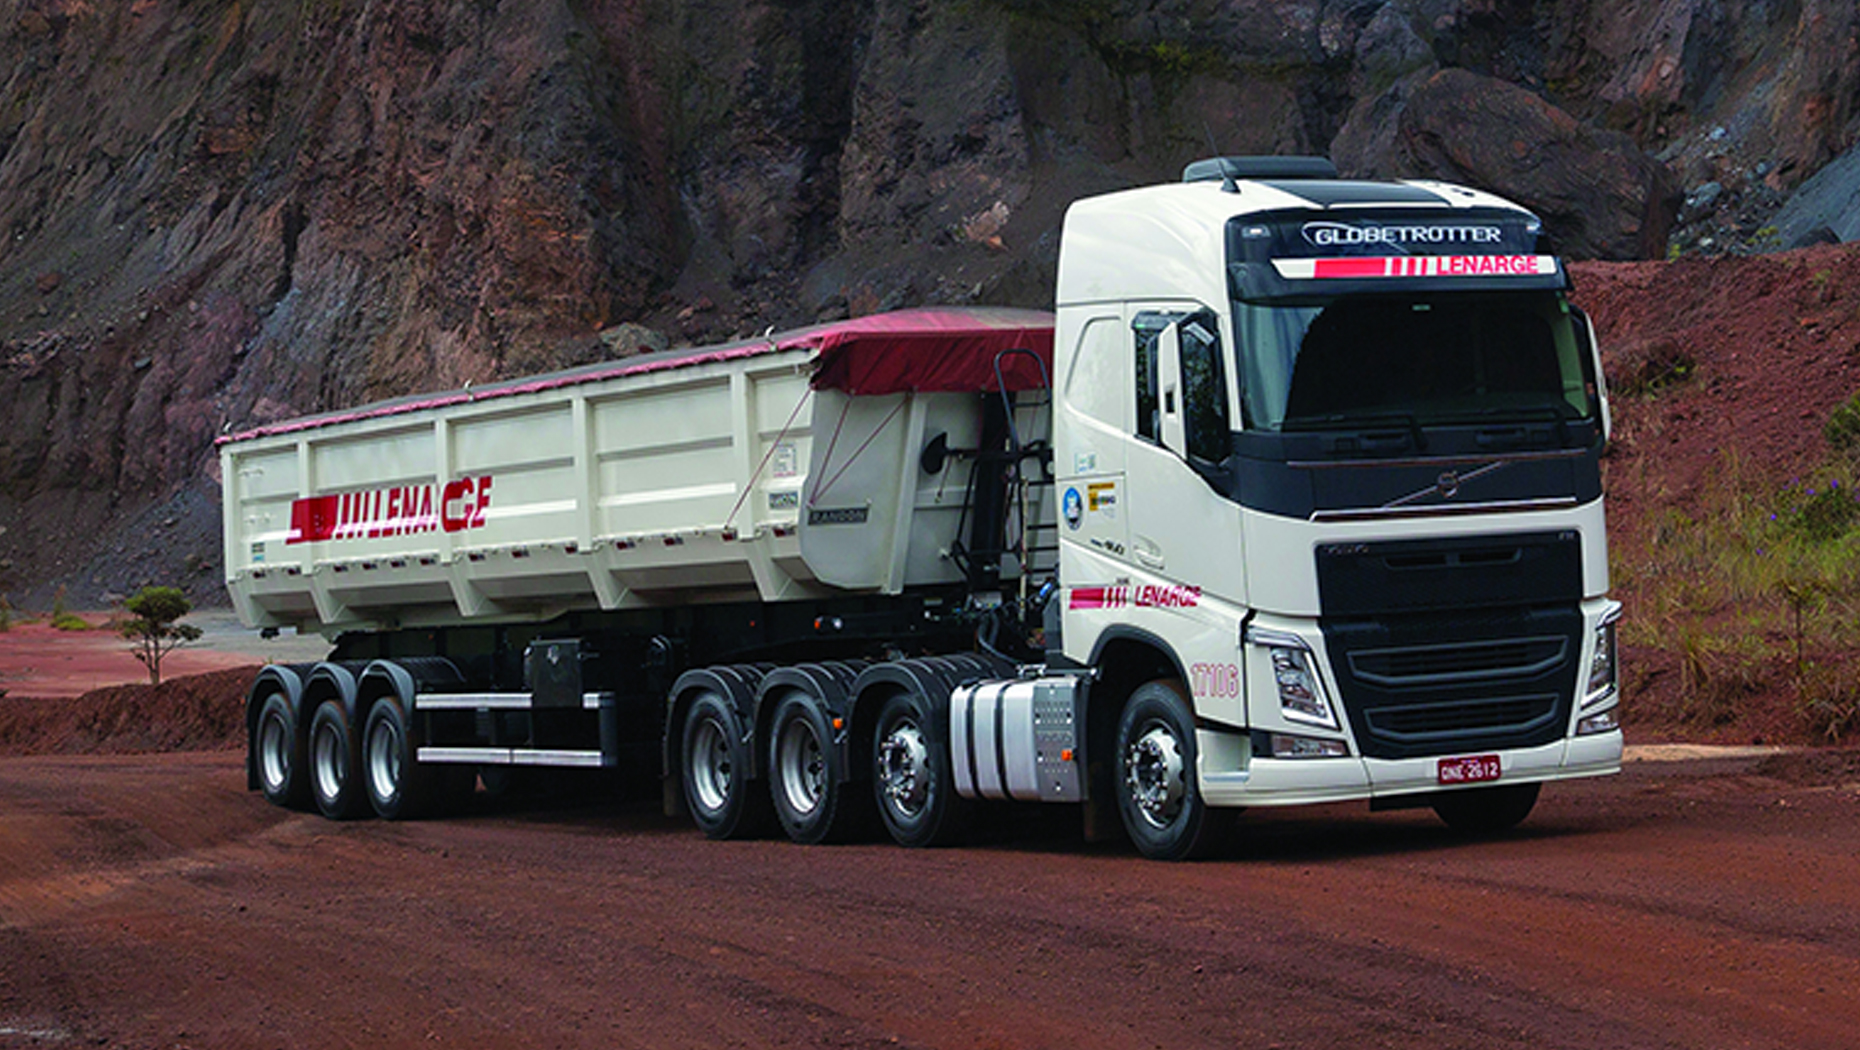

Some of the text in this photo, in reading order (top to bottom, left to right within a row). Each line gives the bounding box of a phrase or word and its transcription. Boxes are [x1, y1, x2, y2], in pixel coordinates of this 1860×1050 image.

[1314, 225, 1501, 245] GLOBETROTTER
[1436, 255, 1539, 275] LENARGE
[1134, 585, 1202, 608] LENARGE
[1190, 662, 1239, 699] 17106
